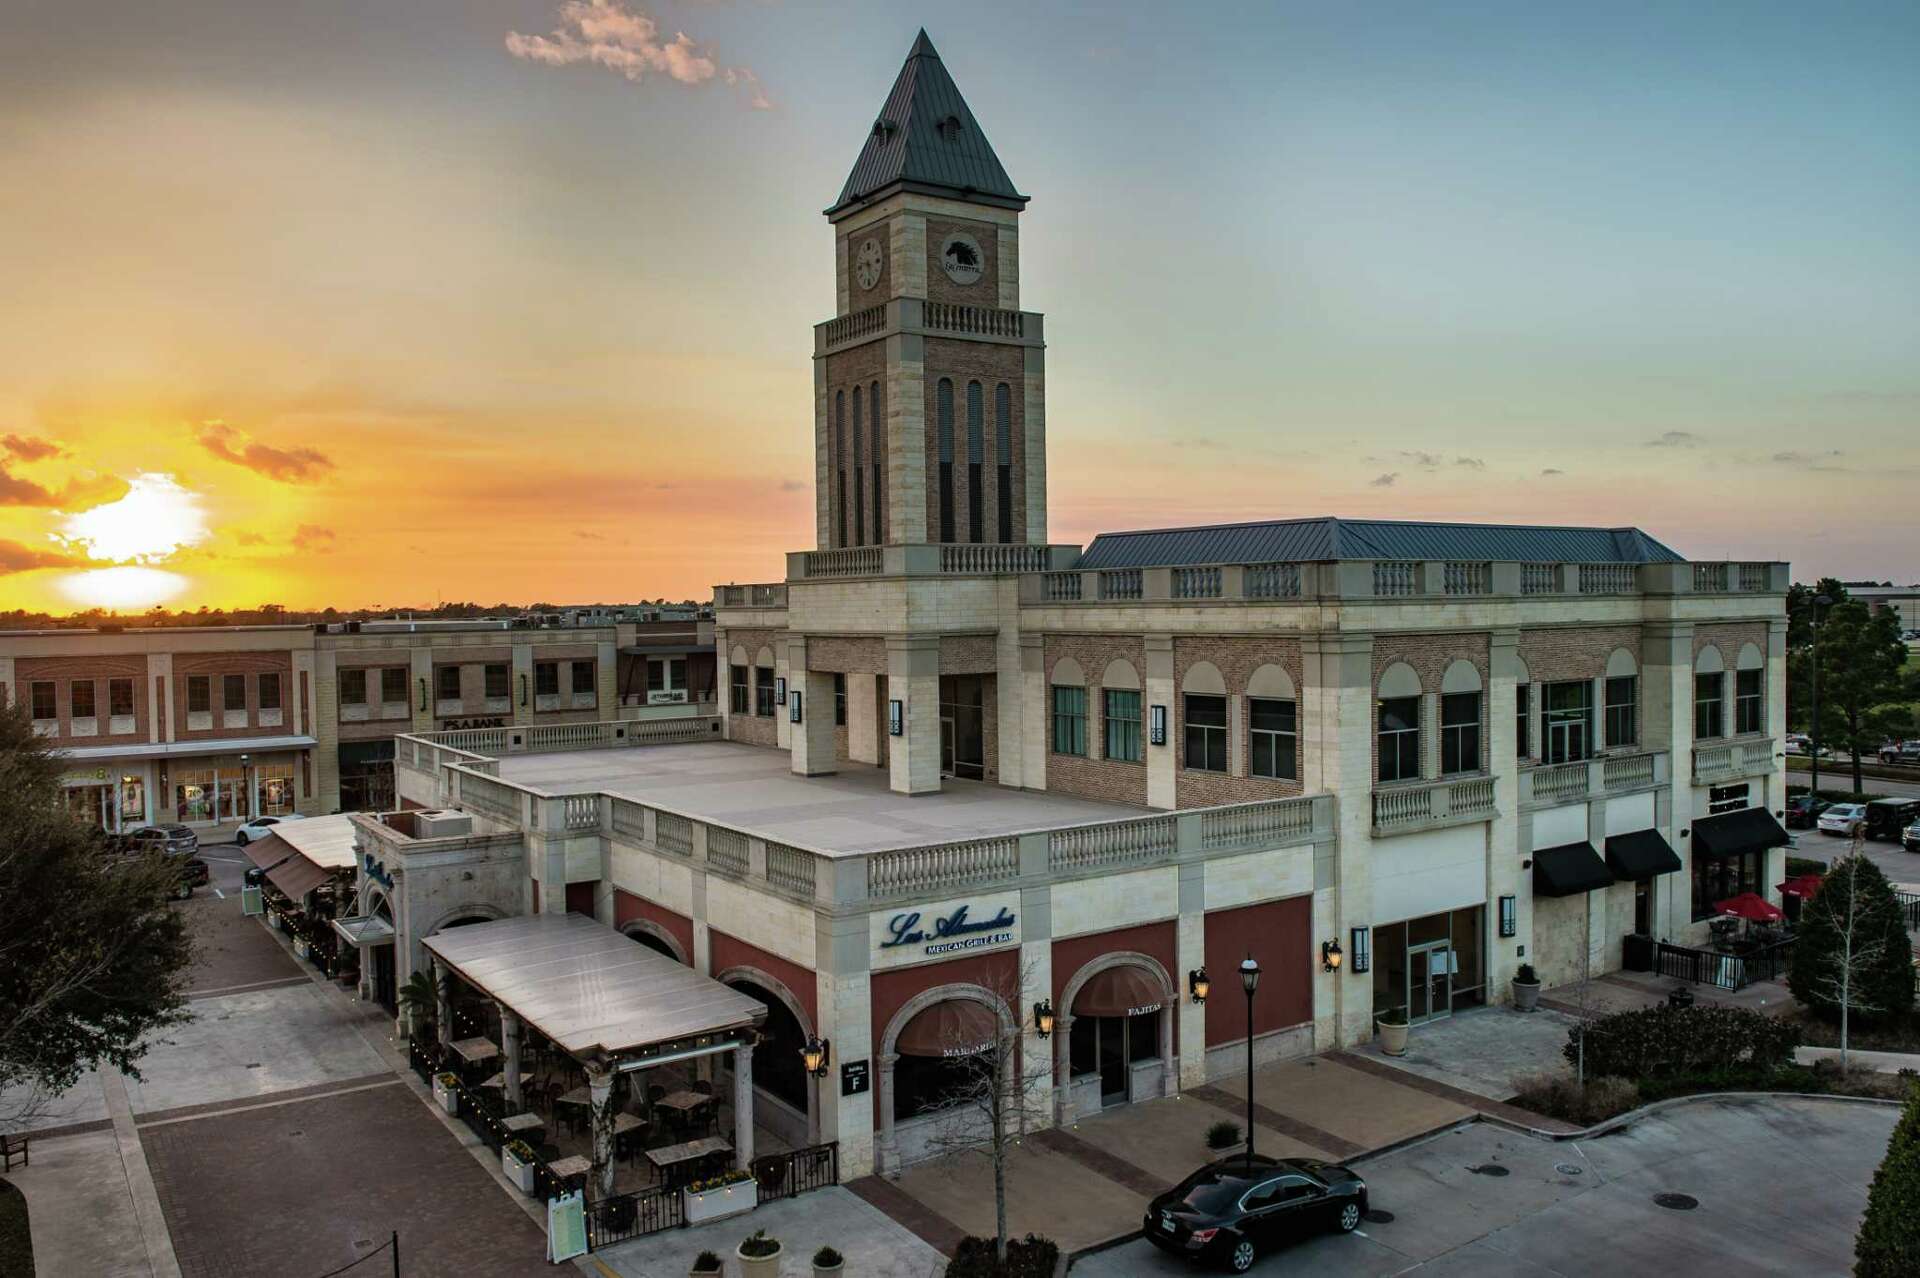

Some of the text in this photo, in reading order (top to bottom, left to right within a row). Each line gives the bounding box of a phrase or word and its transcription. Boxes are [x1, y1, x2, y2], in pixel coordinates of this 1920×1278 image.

[926, 941, 965, 955] MEXICAN
[998, 932, 1014, 943] BAR
[1128, 1004, 1161, 1016] FAJITAS
[852, 1077, 861, 1090] F
